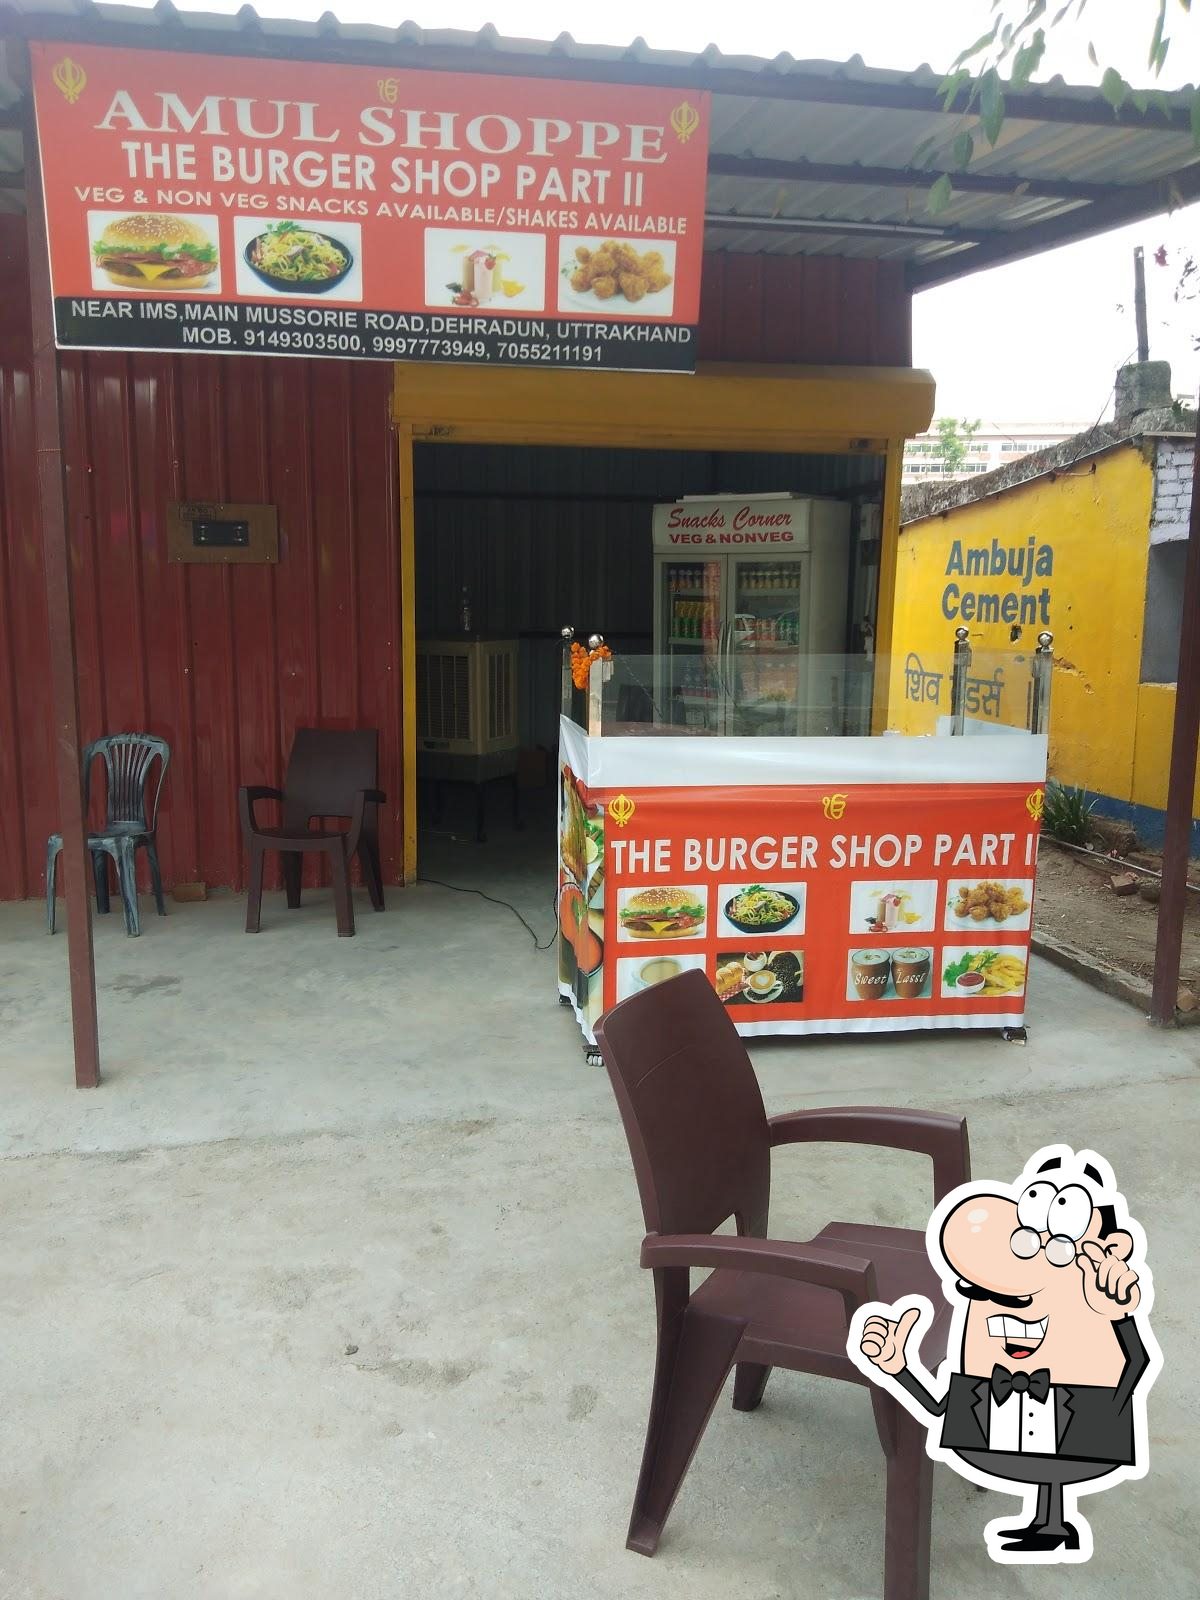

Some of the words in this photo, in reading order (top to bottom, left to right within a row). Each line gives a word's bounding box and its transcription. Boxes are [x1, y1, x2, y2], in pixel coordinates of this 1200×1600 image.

[93, 90, 340, 143] AMUL
[358, 106, 668, 164] SHOPPE
[121, 141, 197, 180] THE
[212, 146, 377, 191] BURGER
[391, 156, 500, 198] SHOP
[516, 165, 610, 204] PART
[623, 172, 644, 206] II
[75, 187, 125, 203] VEG
[134, 190, 149, 204] &
[157, 190, 212, 206] NON
[219, 193, 269, 209] VEG
[276, 196, 369, 216] SNACKS
[376, 202, 579, 229] AVAILABLE/SHAKES
[584, 212, 687, 234] AVAILABLE
[71, 300, 133, 320] NEAR
[140, 303, 238, 326] IMS,MAIN
[246, 307, 357, 328] MUSSORIE
[557, 323, 691, 343] UTTRAKHAND
[183, 328, 237, 345] MOB.
[243, 332, 366, 353] 9149303500,
[373, 337, 491, 360] 9997773949,
[498, 343, 602, 362] 7055211191
[667, 508, 727, 529] Snacks
[733, 506, 792, 531] Corner
[670, 534, 702, 544] VEG
[705, 533, 716, 544] &
[719, 531, 794, 544] NONVEG
[945, 536, 1054, 587] Ambuja
[941, 583, 1051, 625] Cement
[905, 652, 943, 705] शिव
[949, 667, 1005, 718] डर्स
[610, 839, 671, 874] THE
[684, 835, 819, 872] BURGER
[829, 833, 923, 869] SHOP
[933, 833, 1016, 867] PART
[854, 972, 888, 985] Sweet
